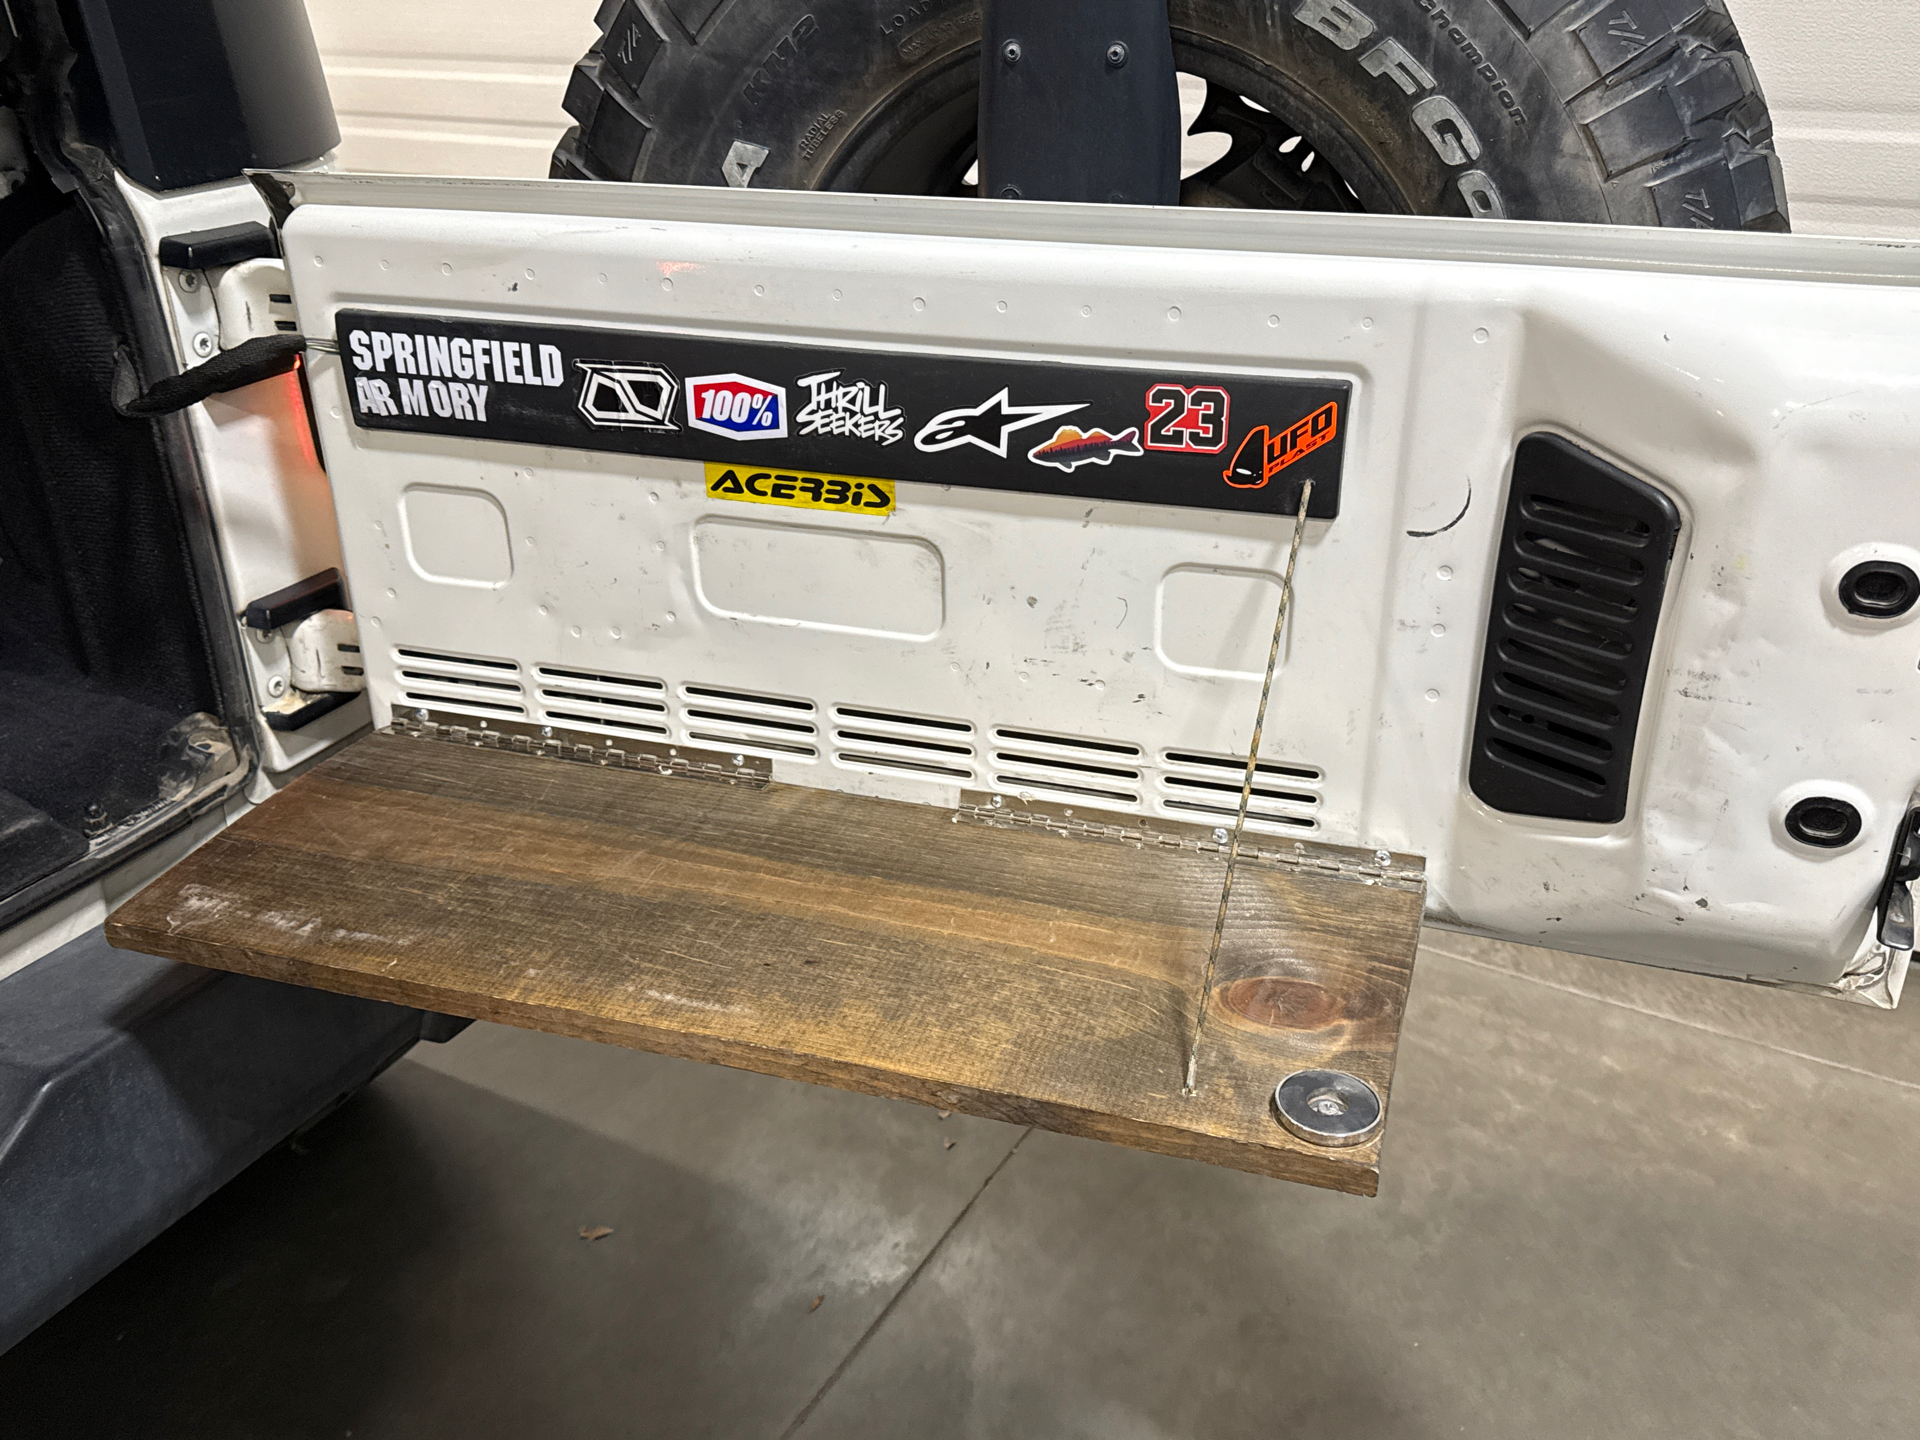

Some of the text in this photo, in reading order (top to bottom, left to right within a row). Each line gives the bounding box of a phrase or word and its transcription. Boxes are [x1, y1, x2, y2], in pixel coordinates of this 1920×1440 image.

[799, 112, 832, 149] RADIAL
[802, 109, 846, 161] TUBELESS
[349, 329, 564, 387] SPRINGFIELD
[701, 388, 774, 427] 100%
[796, 402, 904, 446] SEEKERS
[1147, 386, 1228, 450] 23
[1267, 405, 1334, 465] UFO
